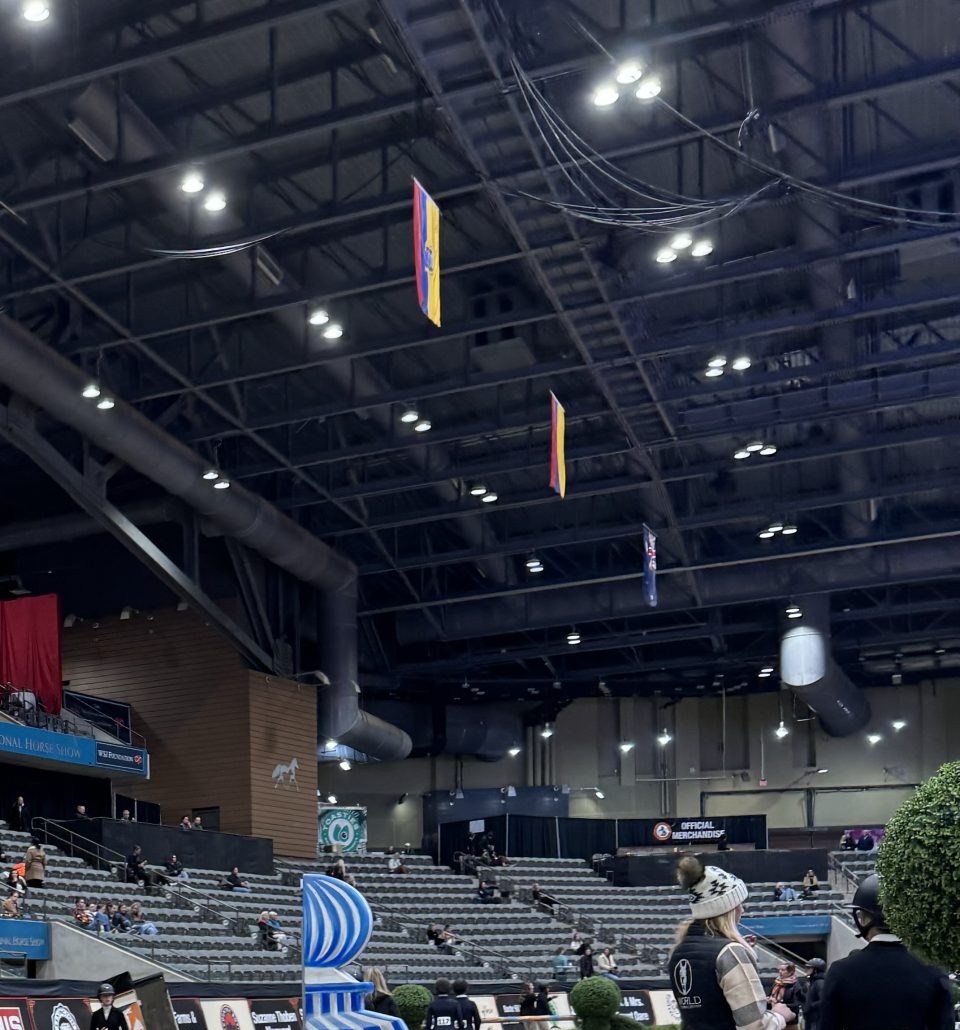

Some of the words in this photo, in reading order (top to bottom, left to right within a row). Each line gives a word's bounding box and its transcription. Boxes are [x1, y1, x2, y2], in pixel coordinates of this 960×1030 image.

[25, 738, 54, 754] HORSE
[56, 744, 81, 758] SHOW
[681, 821, 715, 830] OFFICIAL
[671, 829, 726, 840] MERCHANDISE
